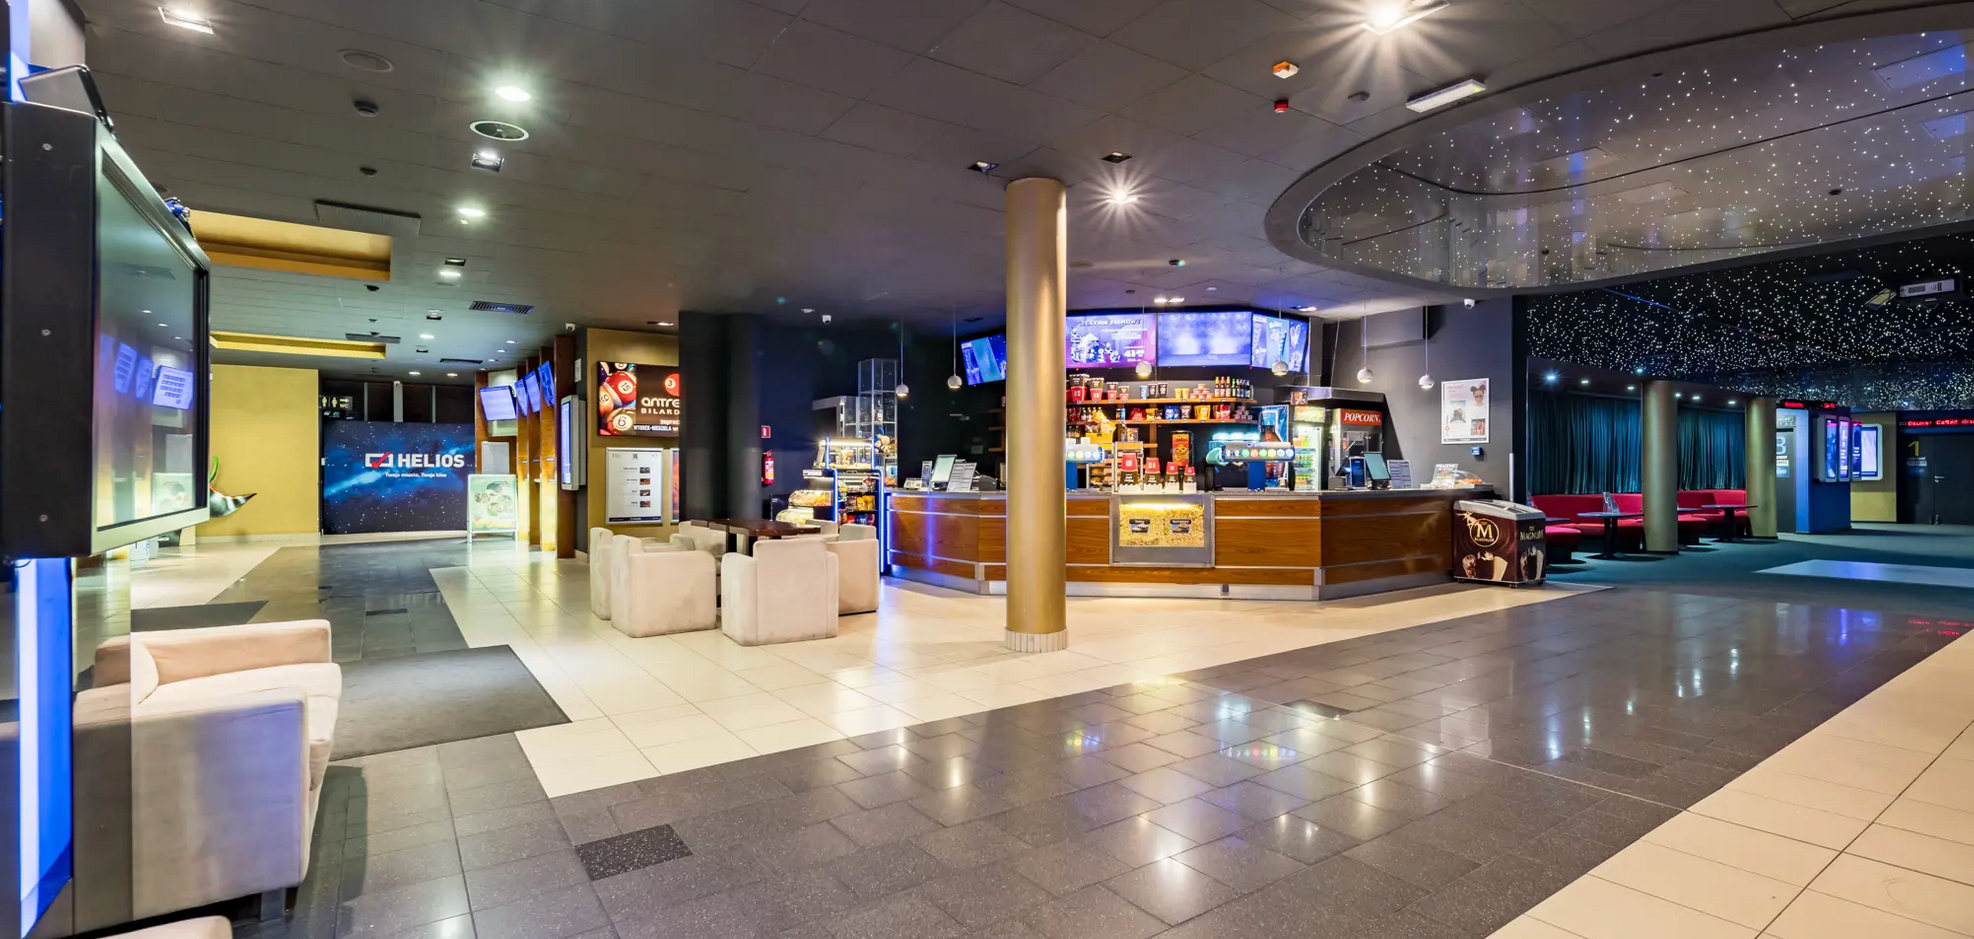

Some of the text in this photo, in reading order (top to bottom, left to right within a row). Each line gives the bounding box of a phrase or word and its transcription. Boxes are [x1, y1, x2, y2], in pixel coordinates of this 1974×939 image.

[1908, 440, 1920, 457] 1
[398, 453, 465, 468] HELIOS
[1475, 524, 1493, 538] M
